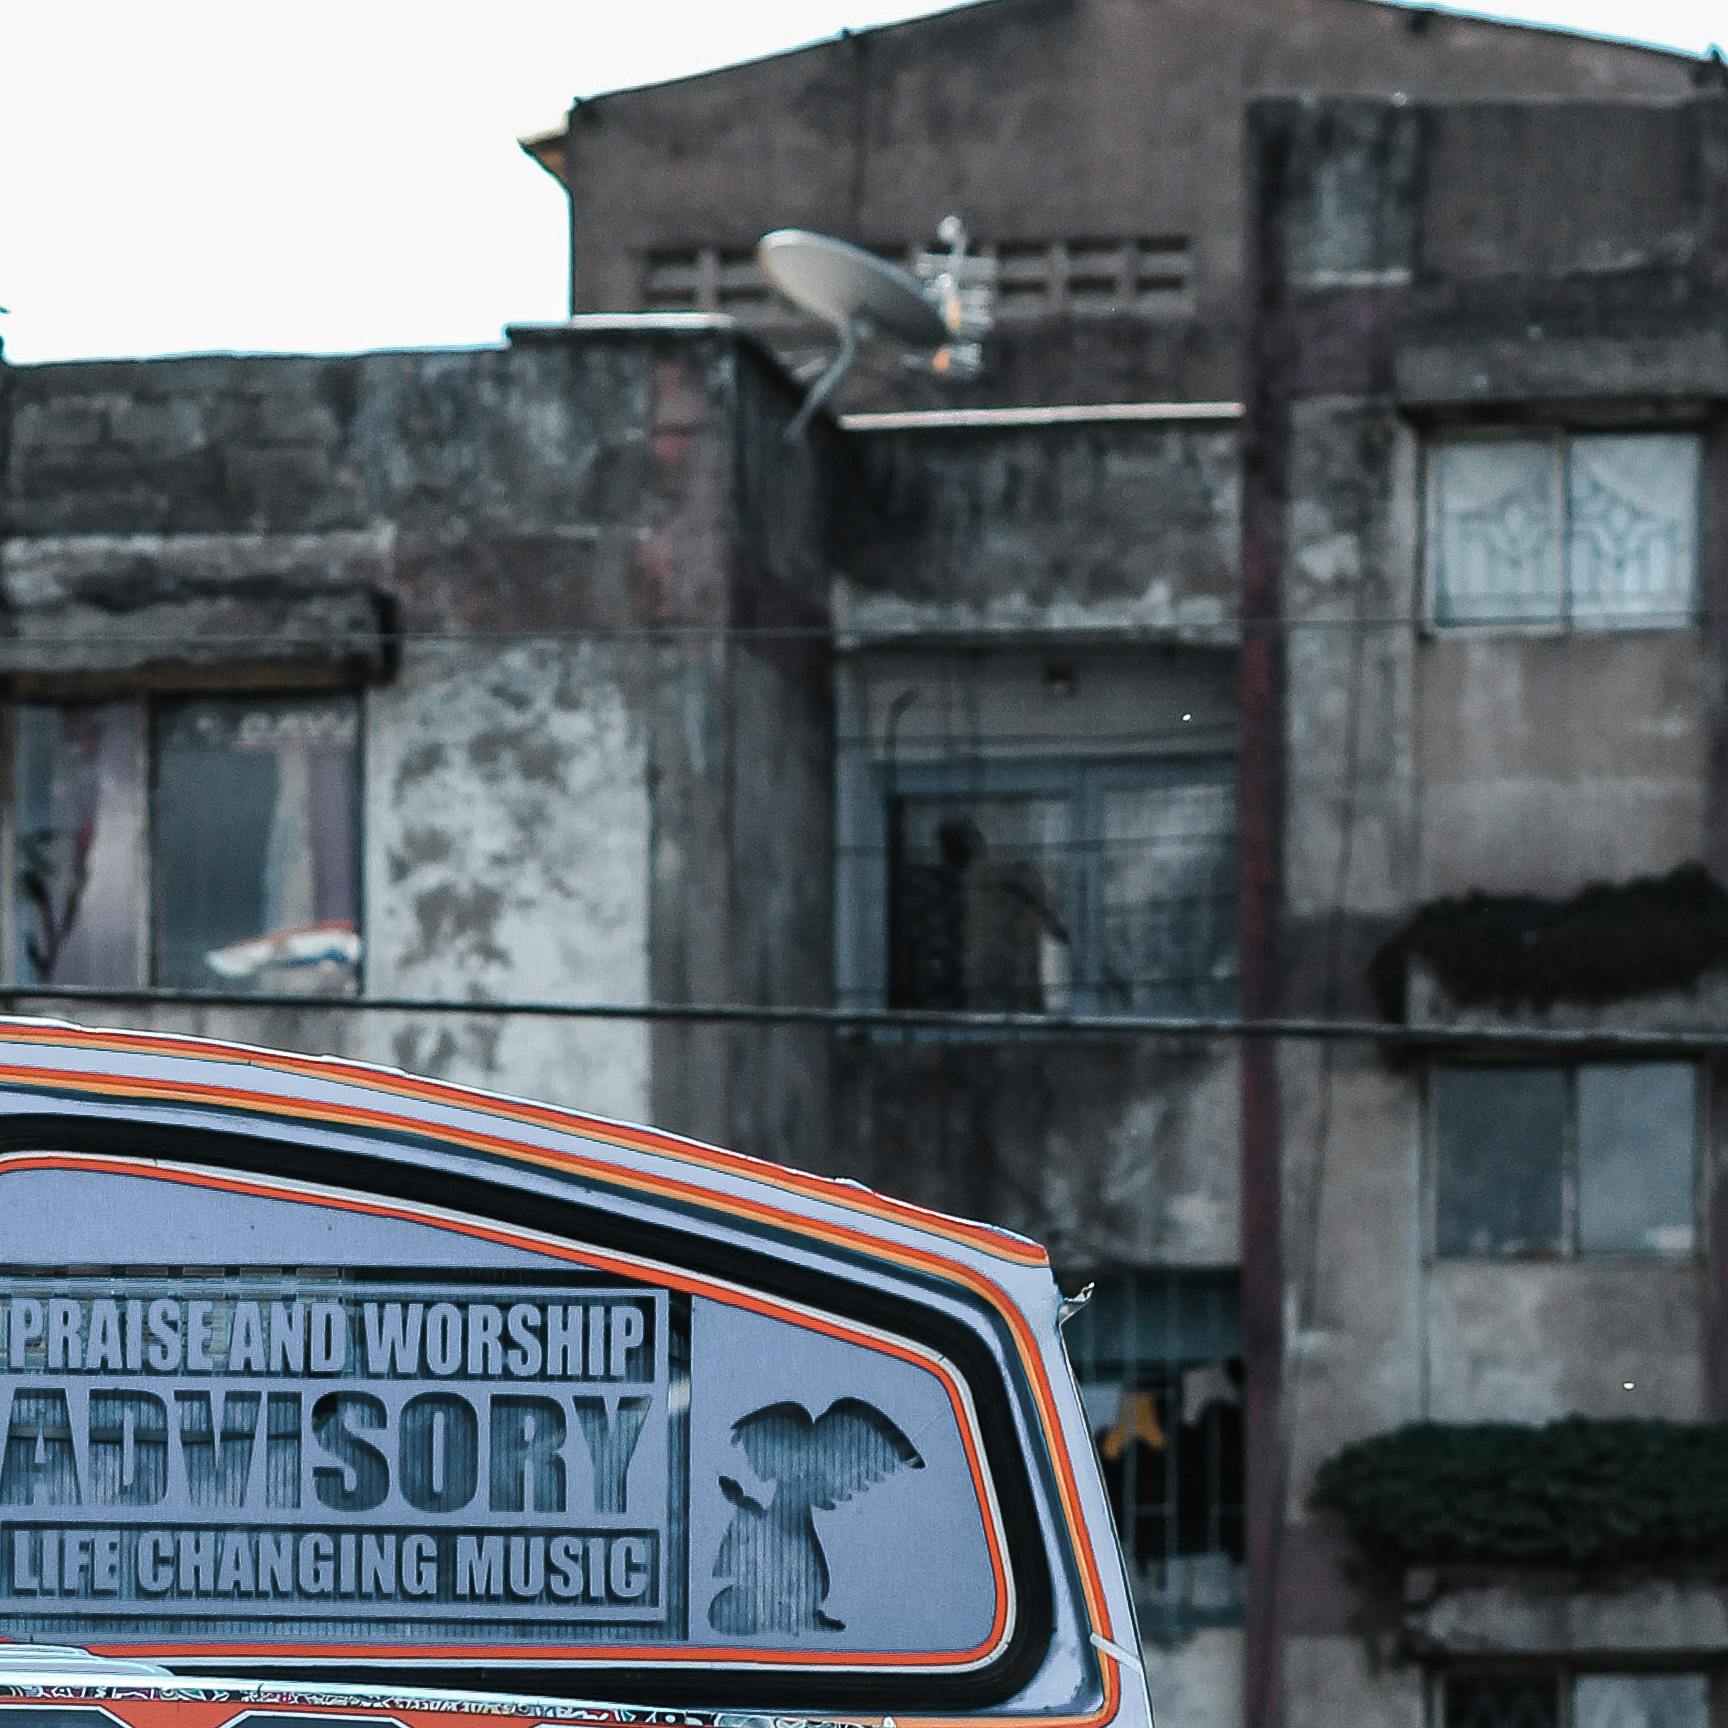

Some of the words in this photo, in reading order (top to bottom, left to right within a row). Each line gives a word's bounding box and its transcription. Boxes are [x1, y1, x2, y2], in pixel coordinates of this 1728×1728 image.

[11, 1296, 219, 1375] PRAISE
[230, 1300, 348, 1376] AND
[366, 1301, 645, 1381] WORSHIP
[13, 1533, 120, 1598] LIFE
[138, 1535, 441, 1600] CHANGING
[455, 1535, 648, 1600] MUSIC
